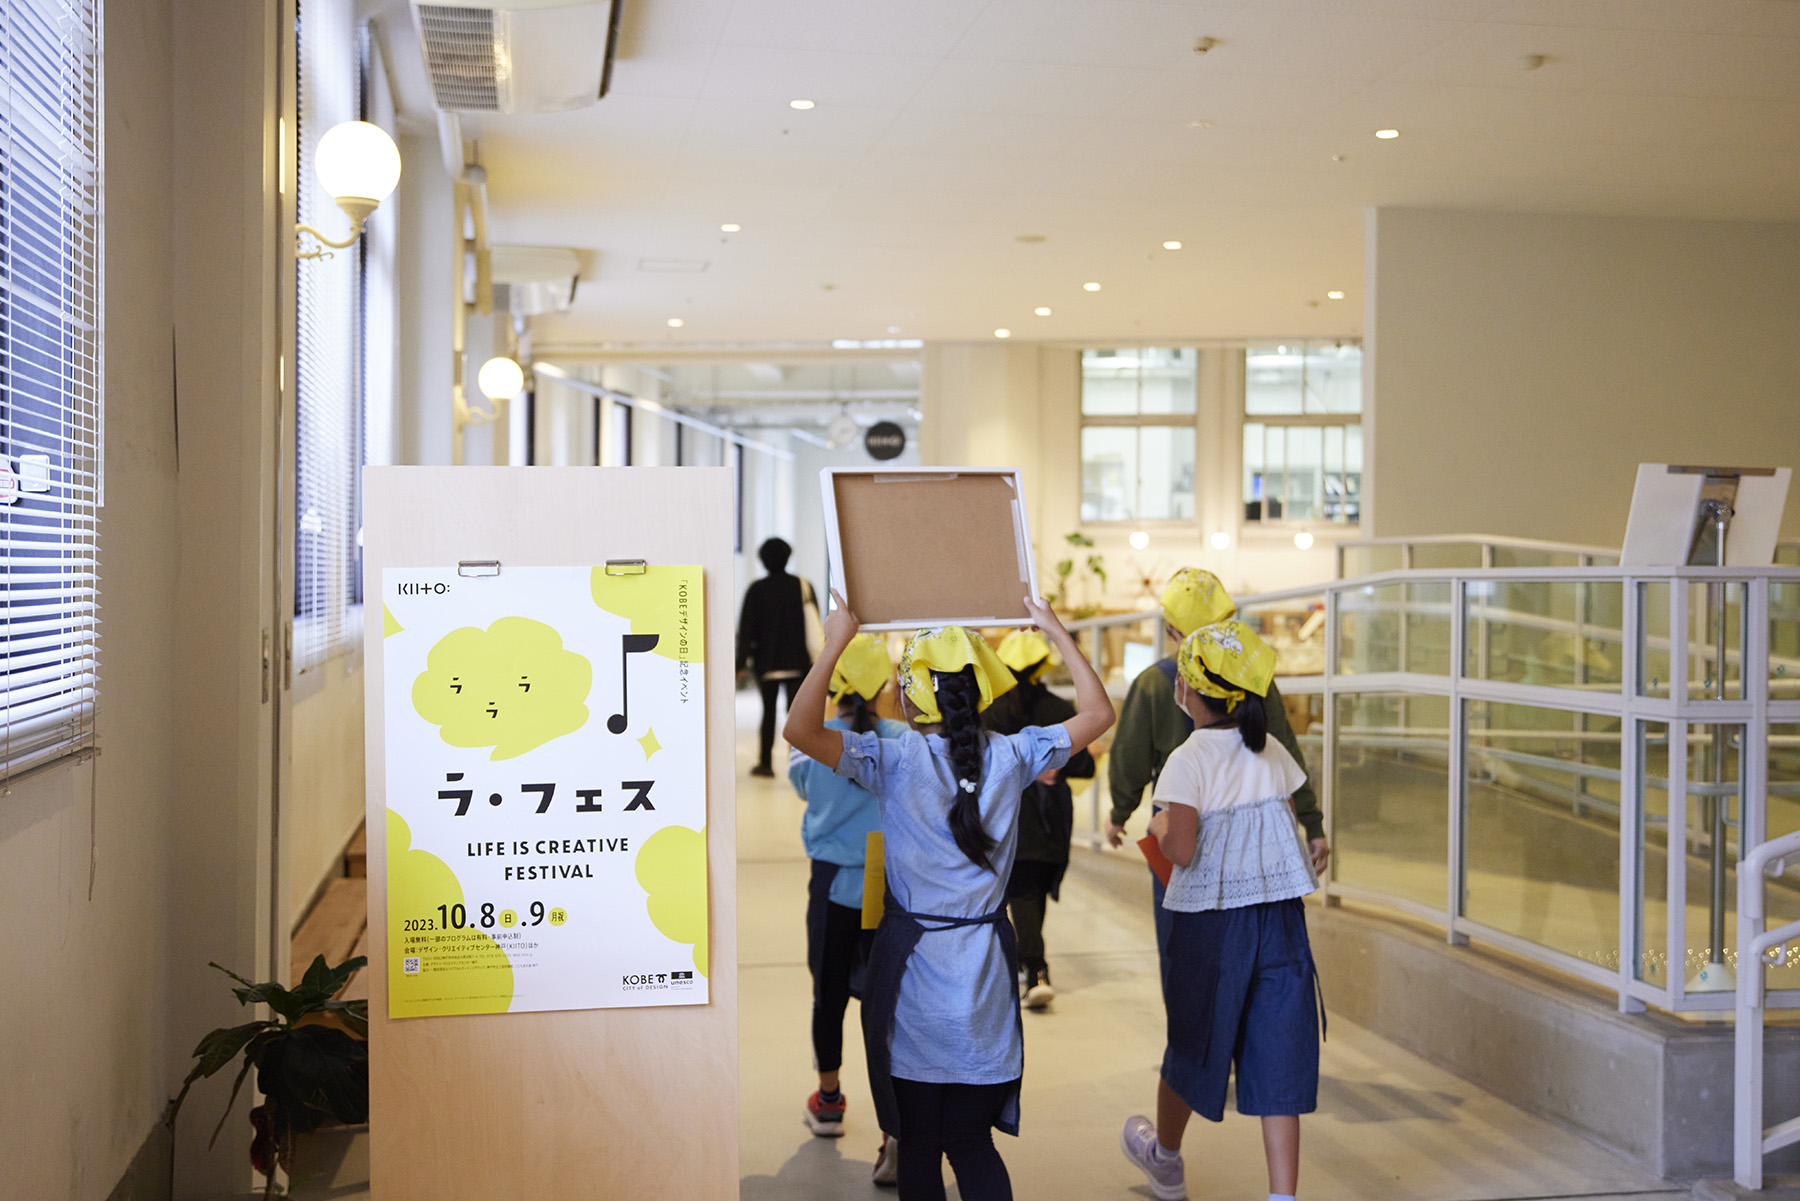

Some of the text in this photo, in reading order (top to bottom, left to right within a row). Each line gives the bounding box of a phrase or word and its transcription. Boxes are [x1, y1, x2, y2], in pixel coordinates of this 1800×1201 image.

[450, 675, 531, 694] ラ ラ
[486, 701, 499, 719] ラ
[437, 772, 656, 816] ラ・フェス
[467, 837, 629, 857] LIFE IS CREATIVE
[504, 864, 593, 881] FESTIVAL
[622, 974, 654, 985] KOBE
